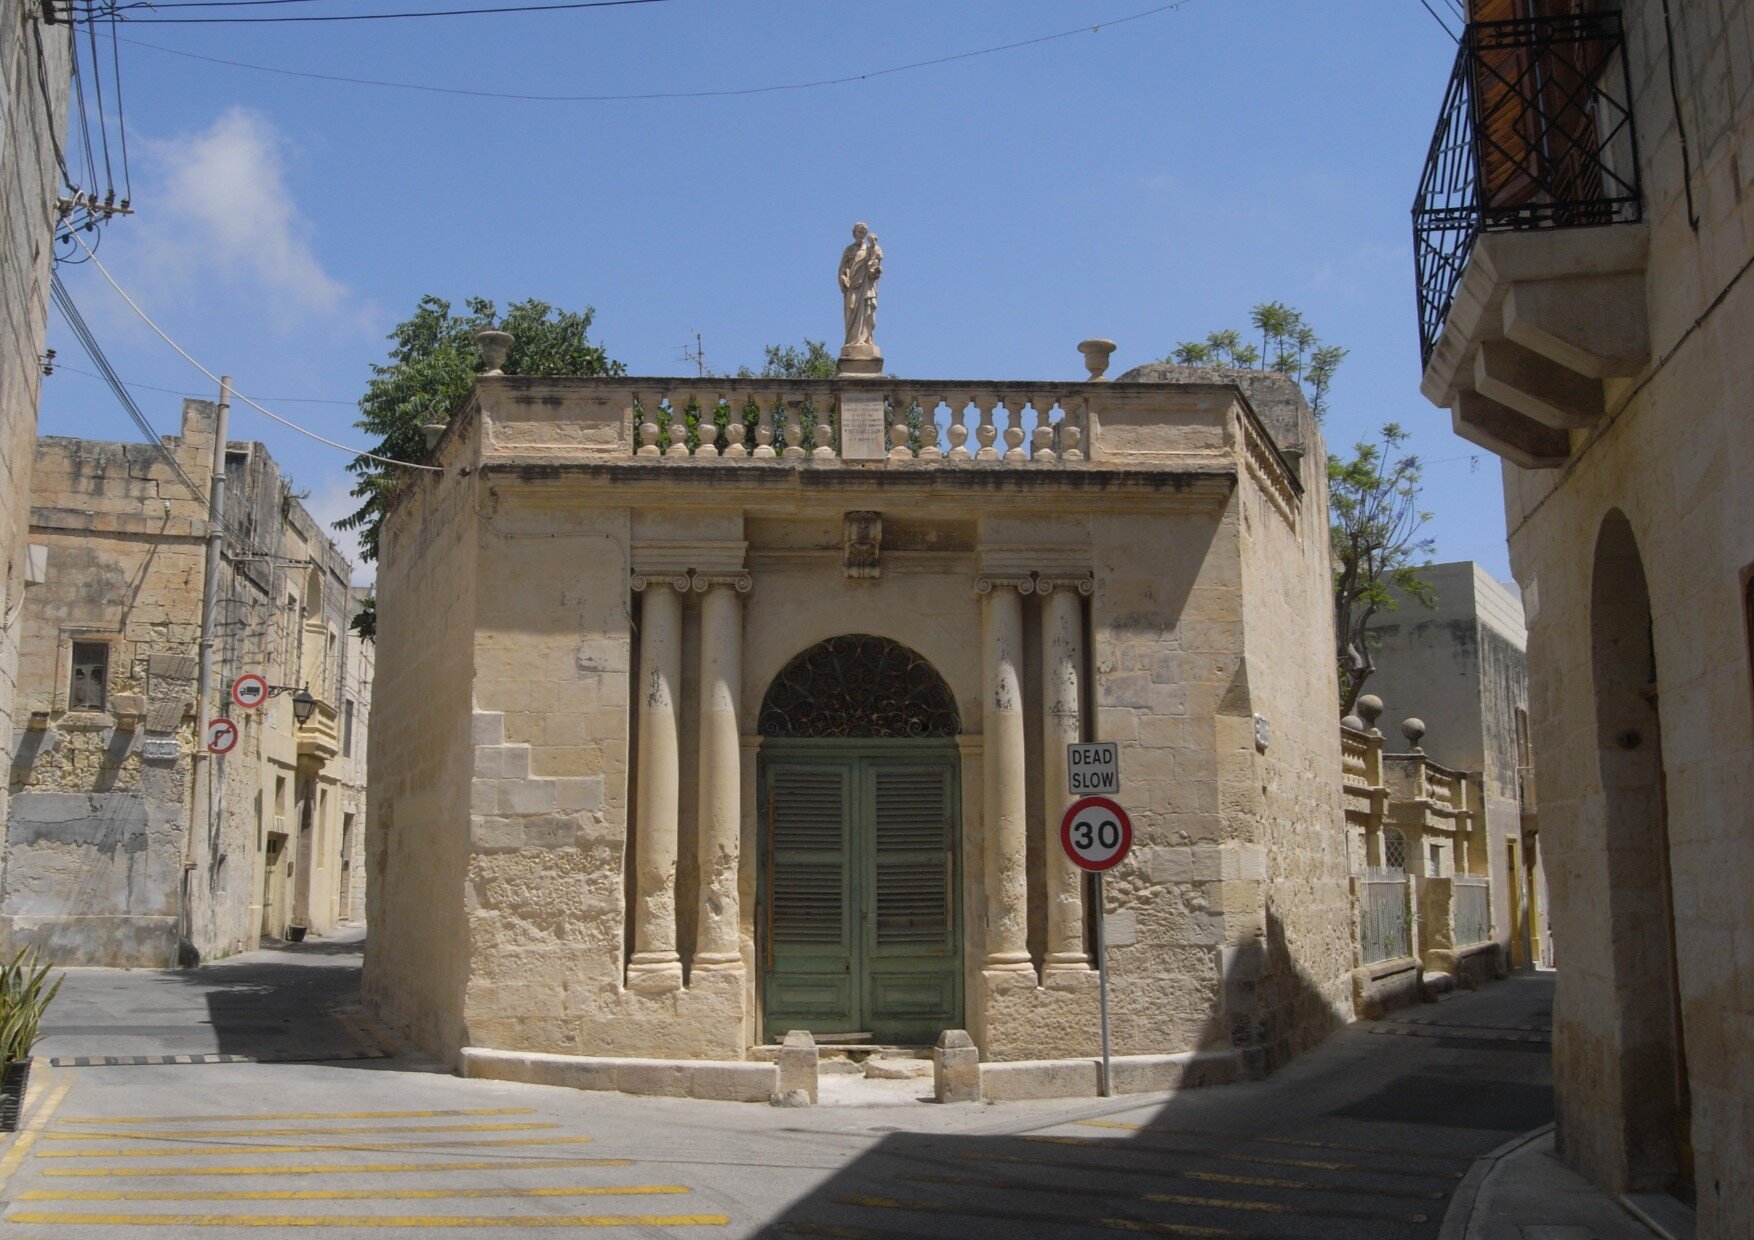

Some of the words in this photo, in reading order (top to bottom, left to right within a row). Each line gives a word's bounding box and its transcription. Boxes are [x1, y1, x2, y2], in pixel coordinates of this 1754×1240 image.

[1072, 749, 1112, 765] DEAD
[1072, 772, 1114, 788] SLOW
[1074, 820, 1119, 850] 30
